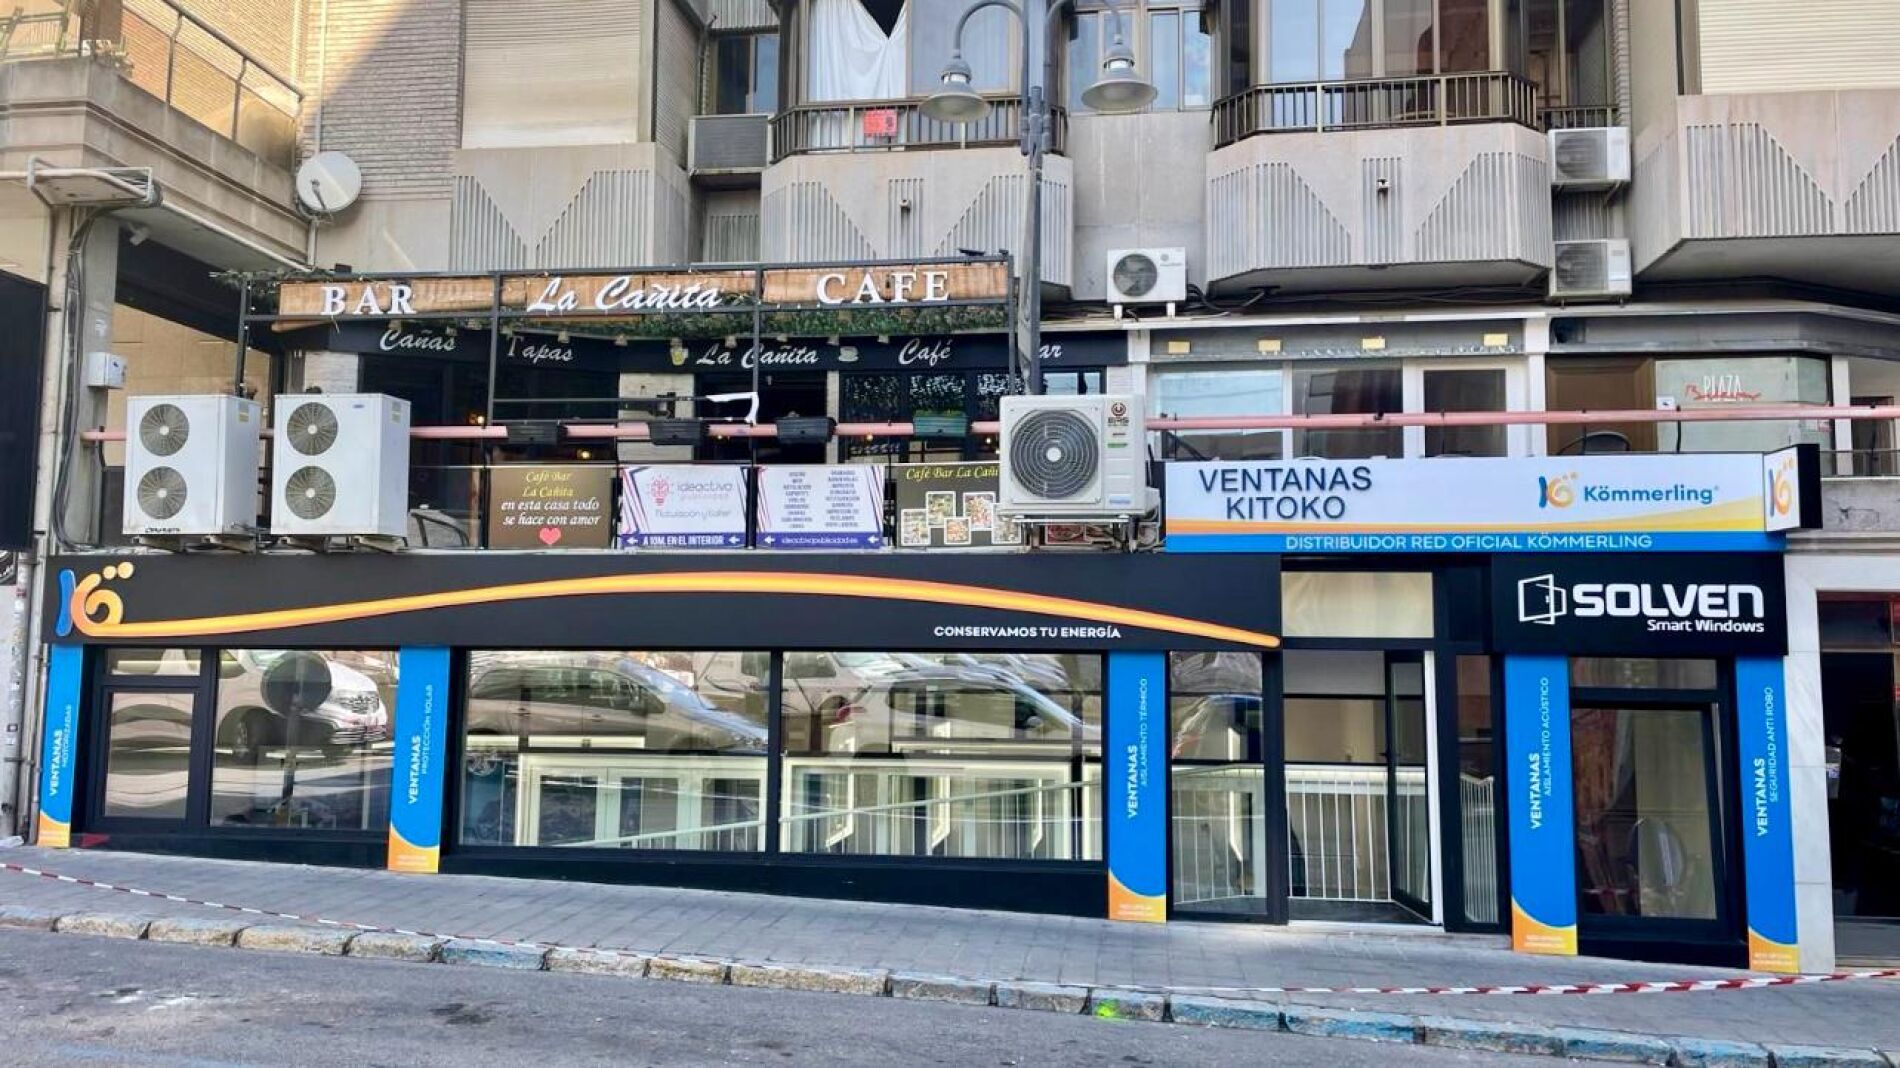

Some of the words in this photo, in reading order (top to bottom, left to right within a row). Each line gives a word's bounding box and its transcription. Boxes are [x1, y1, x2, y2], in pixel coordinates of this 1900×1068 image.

[320, 284, 417, 315] BAR
[526, 277, 578, 313] La
[595, 276, 723, 311] Cañita
[816, 270, 949, 304] CAFE
[379, 328, 457, 351] Cañas
[507, 336, 574, 362] Tapas
[898, 338, 954, 366] Café
[1039, 344, 1063, 359] ar
[696, 342, 731, 365] La
[741, 342, 820, 369] Cañita
[1199, 466, 1373, 493] VENTANAS
[501, 501, 516, 511] en
[518, 501, 541, 511] esta
[544, 502, 570, 511] casa
[574, 496, 600, 511] todo
[1226, 497, 1346, 519] KITOKO
[1584, 485, 1713, 506] Kömmerling
[503, 515, 516, 526] se
[518, 511, 545, 525] hace
[547, 516, 567, 525] con
[569, 515, 601, 525] amor
[1286, 536, 1406, 549] DISTRIBUIDOR
[1411, 536, 1447, 549] RED
[1451, 535, 1522, 548] OFICIAL
[1527, 532, 1652, 548] KÖMMERLING
[1572, 584, 1765, 618] SOLVEN
[934, 627, 1036, 637] CONSERVAMOS
[1039, 627, 1058, 637] TU
[1060, 625, 1121, 638] ENERGÍA
[1647, 619, 1692, 631] Smart
[1695, 619, 1765, 633] Windows
[1139, 678, 1148, 720] TÉRMICO
[1539, 677, 1550, 728] ACÚSTICO
[1764, 687, 1774, 716] ROBO
[1767, 717, 1777, 742] ANTI
[49, 729, 62, 796] VENTANAS
[408, 735, 421, 804] VENTANAS
[1139, 723, 1148, 787] AISLAMIENTO
[1542, 731, 1552, 796] AISLAMIENTO
[1127, 744, 1138, 818] VENTANAS
[1769, 743, 1778, 802] SEGURIDAD
[1528, 752, 1542, 829] VENTANAS
[1753, 758, 1768, 836] VENTANAS
